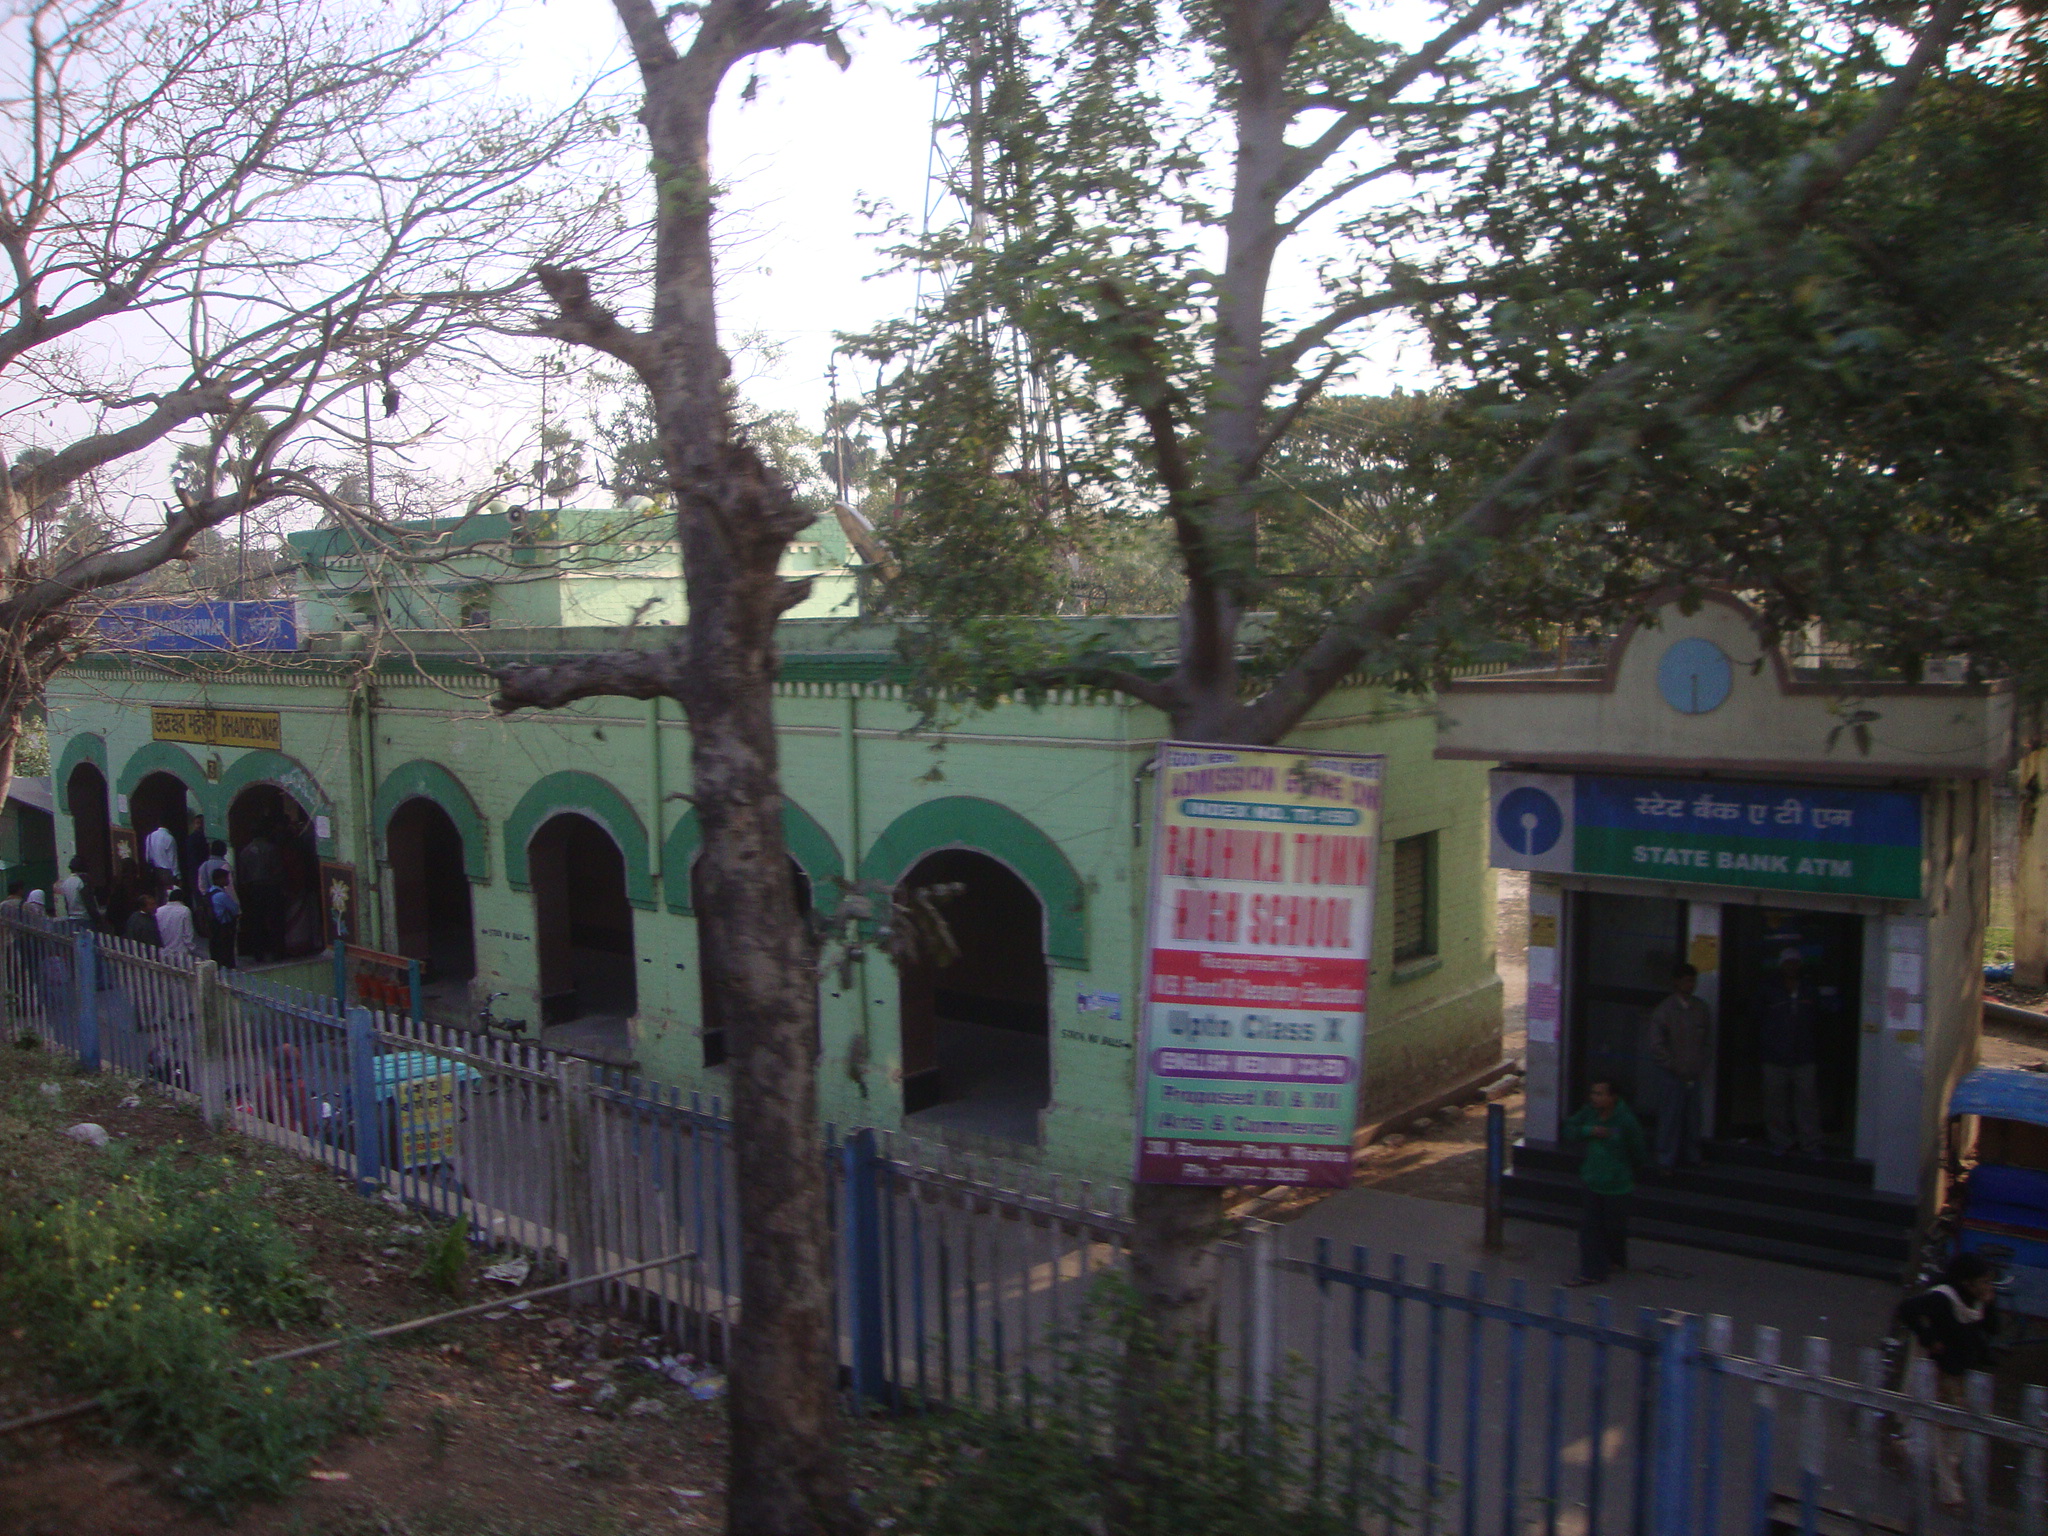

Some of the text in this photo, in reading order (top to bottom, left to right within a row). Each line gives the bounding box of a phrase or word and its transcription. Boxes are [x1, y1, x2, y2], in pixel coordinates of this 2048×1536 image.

[221, 715, 279, 742] BHADRESWAR
[1633, 791, 1685, 819] स्टेट
[1748, 804, 1767, 825] ए
[1773, 798, 1803, 825] टी
[1811, 808, 1853, 829] एम
[1632, 845, 1853, 879] STATE BANK ATM
[1247, 893, 1352, 948] SCHOOL
[1240, 1012, 1316, 1042] Class
[1322, 1016, 1345, 1043] X
